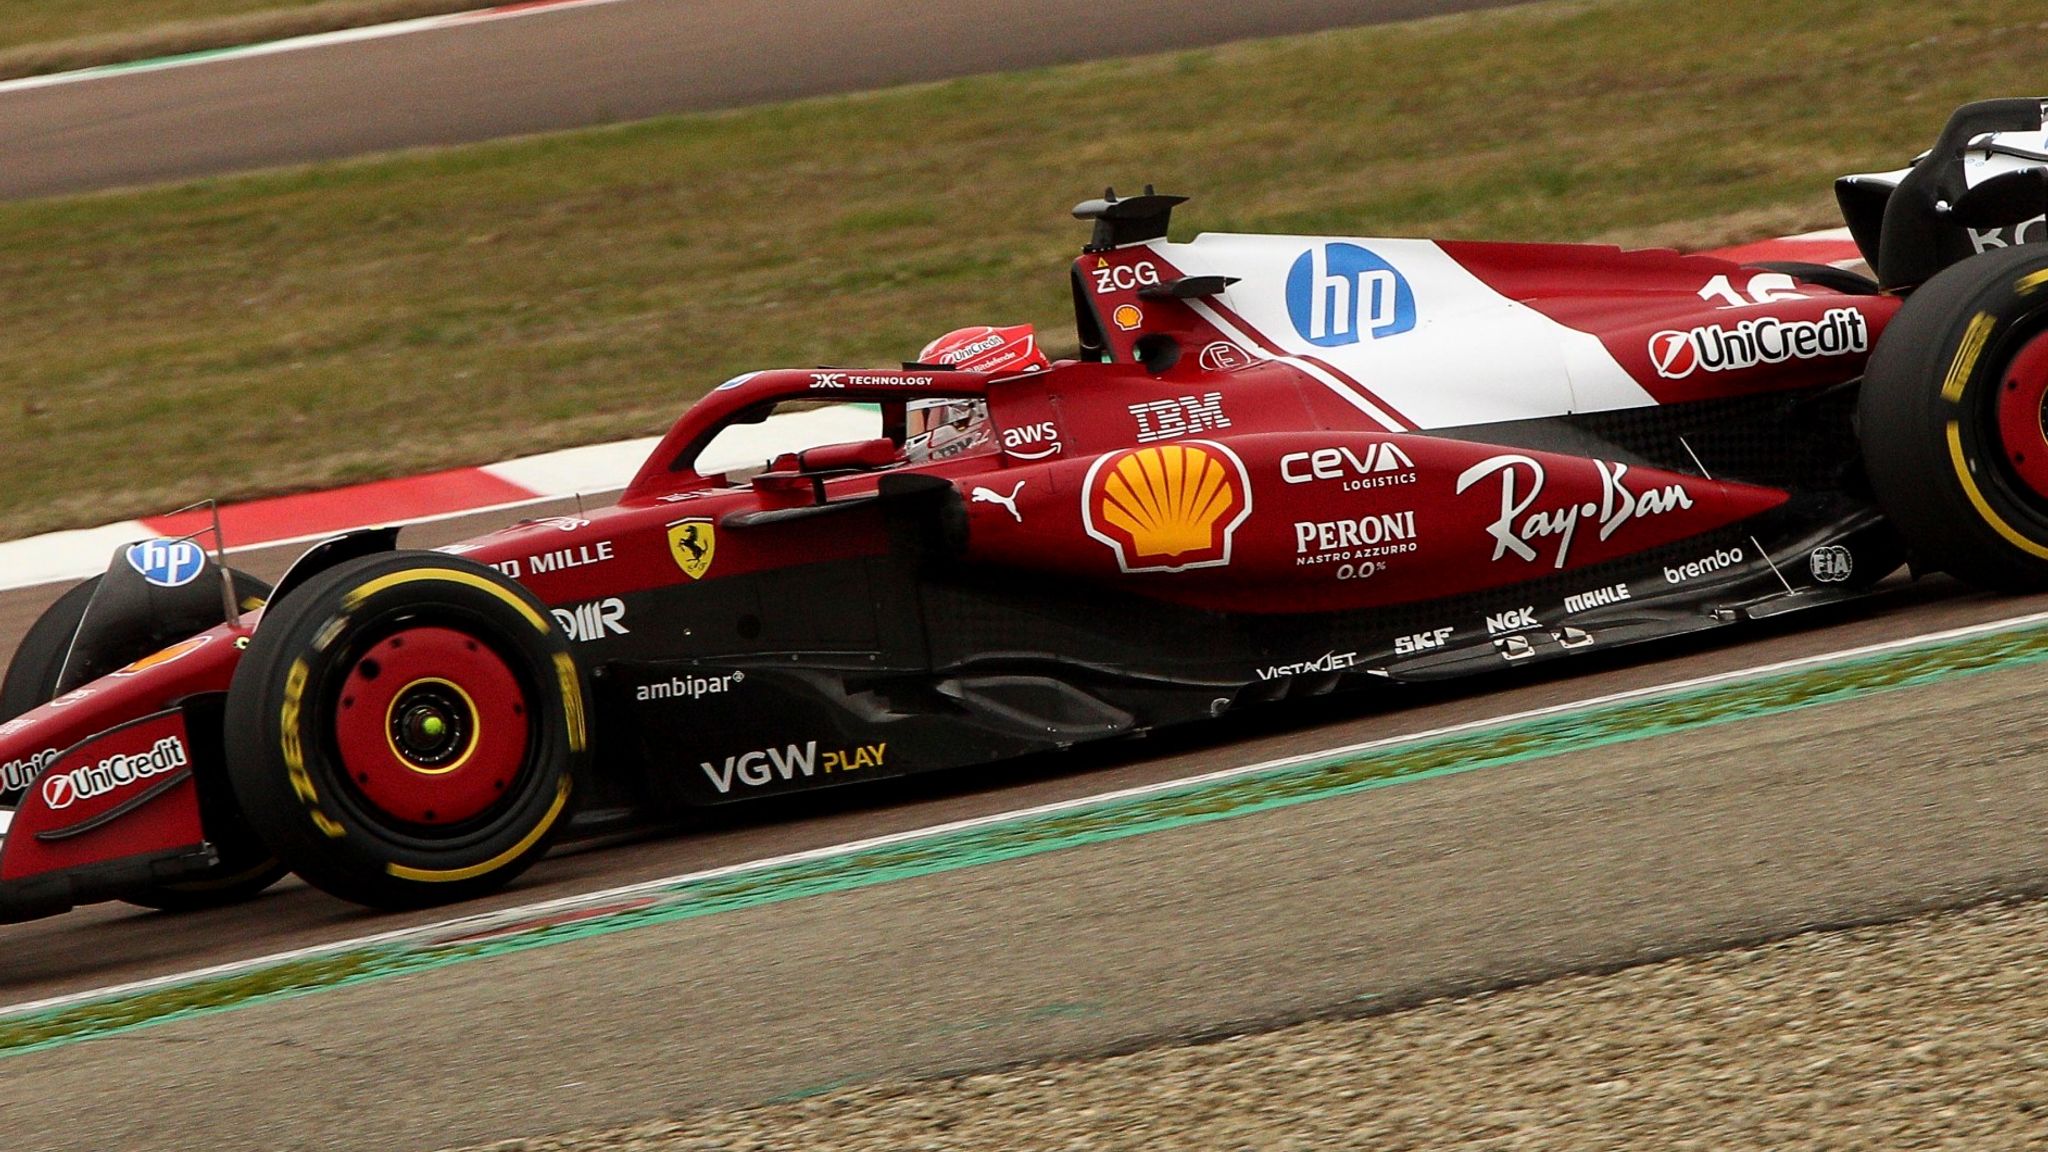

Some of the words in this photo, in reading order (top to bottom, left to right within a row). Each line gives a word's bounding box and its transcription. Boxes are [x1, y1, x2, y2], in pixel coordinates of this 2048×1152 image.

[1309, 243, 1398, 344] hp
[953, 335, 1005, 362] UniCredit
[1694, 309, 1867, 370] UniCredit
[848, 375, 933, 387] TECHNOLOGY
[1128, 392, 1231, 443] IBM
[1003, 422, 1058, 448] aws
[1343, 473, 1416, 491] LOGISTICS
[1294, 511, 1416, 553] PERONI
[143, 539, 193, 585] hp
[529, 541, 614, 575] MILLE
[1297, 552, 1351, 565] NASTRO
[1354, 543, 1417, 559] AZZURRO
[1664, 547, 1743, 584] brembo
[1813, 553, 1848, 574] FIA
[1336, 561, 1387, 580] 0.0%
[1564, 584, 1631, 613] MAHLE
[1486, 606, 1538, 633] NGK
[1394, 627, 1454, 655] SKF
[1256, 650, 1357, 680] VISTAJET
[636, 675, 732, 700] ambipar
[72, 738, 185, 797] UniCredit
[700, 741, 817, 793] VGW
[822, 743, 887, 773] PLAY
